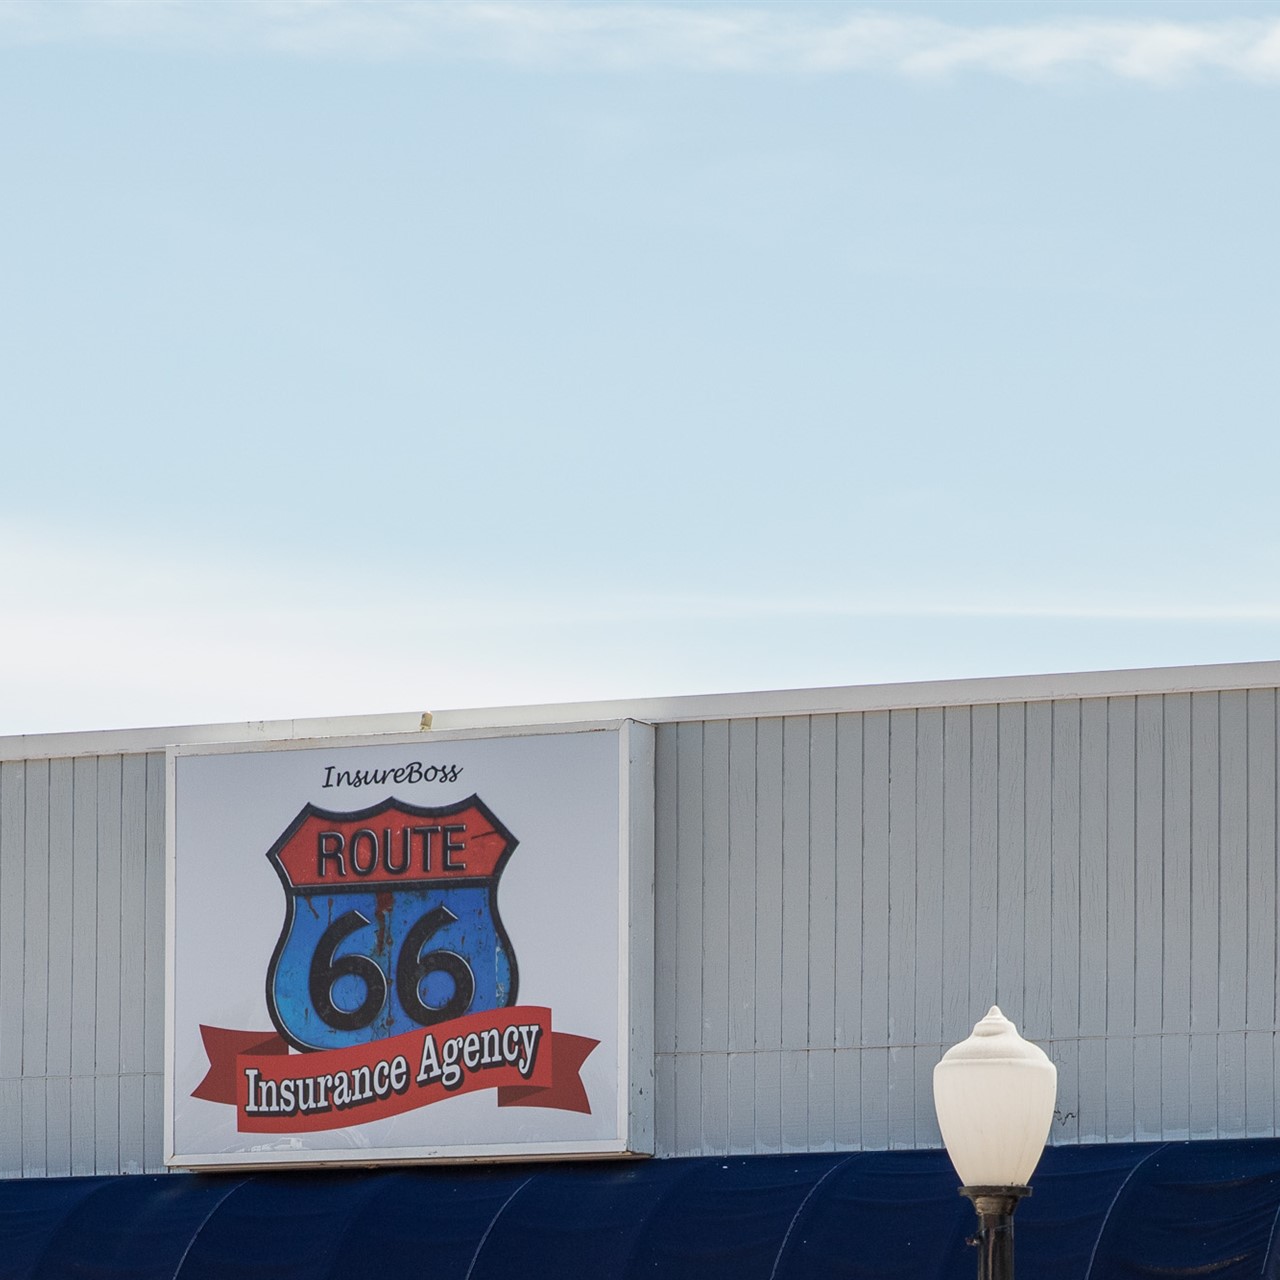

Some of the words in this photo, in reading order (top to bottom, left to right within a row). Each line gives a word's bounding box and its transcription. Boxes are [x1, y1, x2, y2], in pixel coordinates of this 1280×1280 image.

[321, 761, 465, 789] InsureBoss
[316, 824, 468, 877] ROUTE
[308, 905, 476, 1032] 66
[244, 1055, 408, 1114] Insurance
[416, 1024, 540, 1087] Agency
